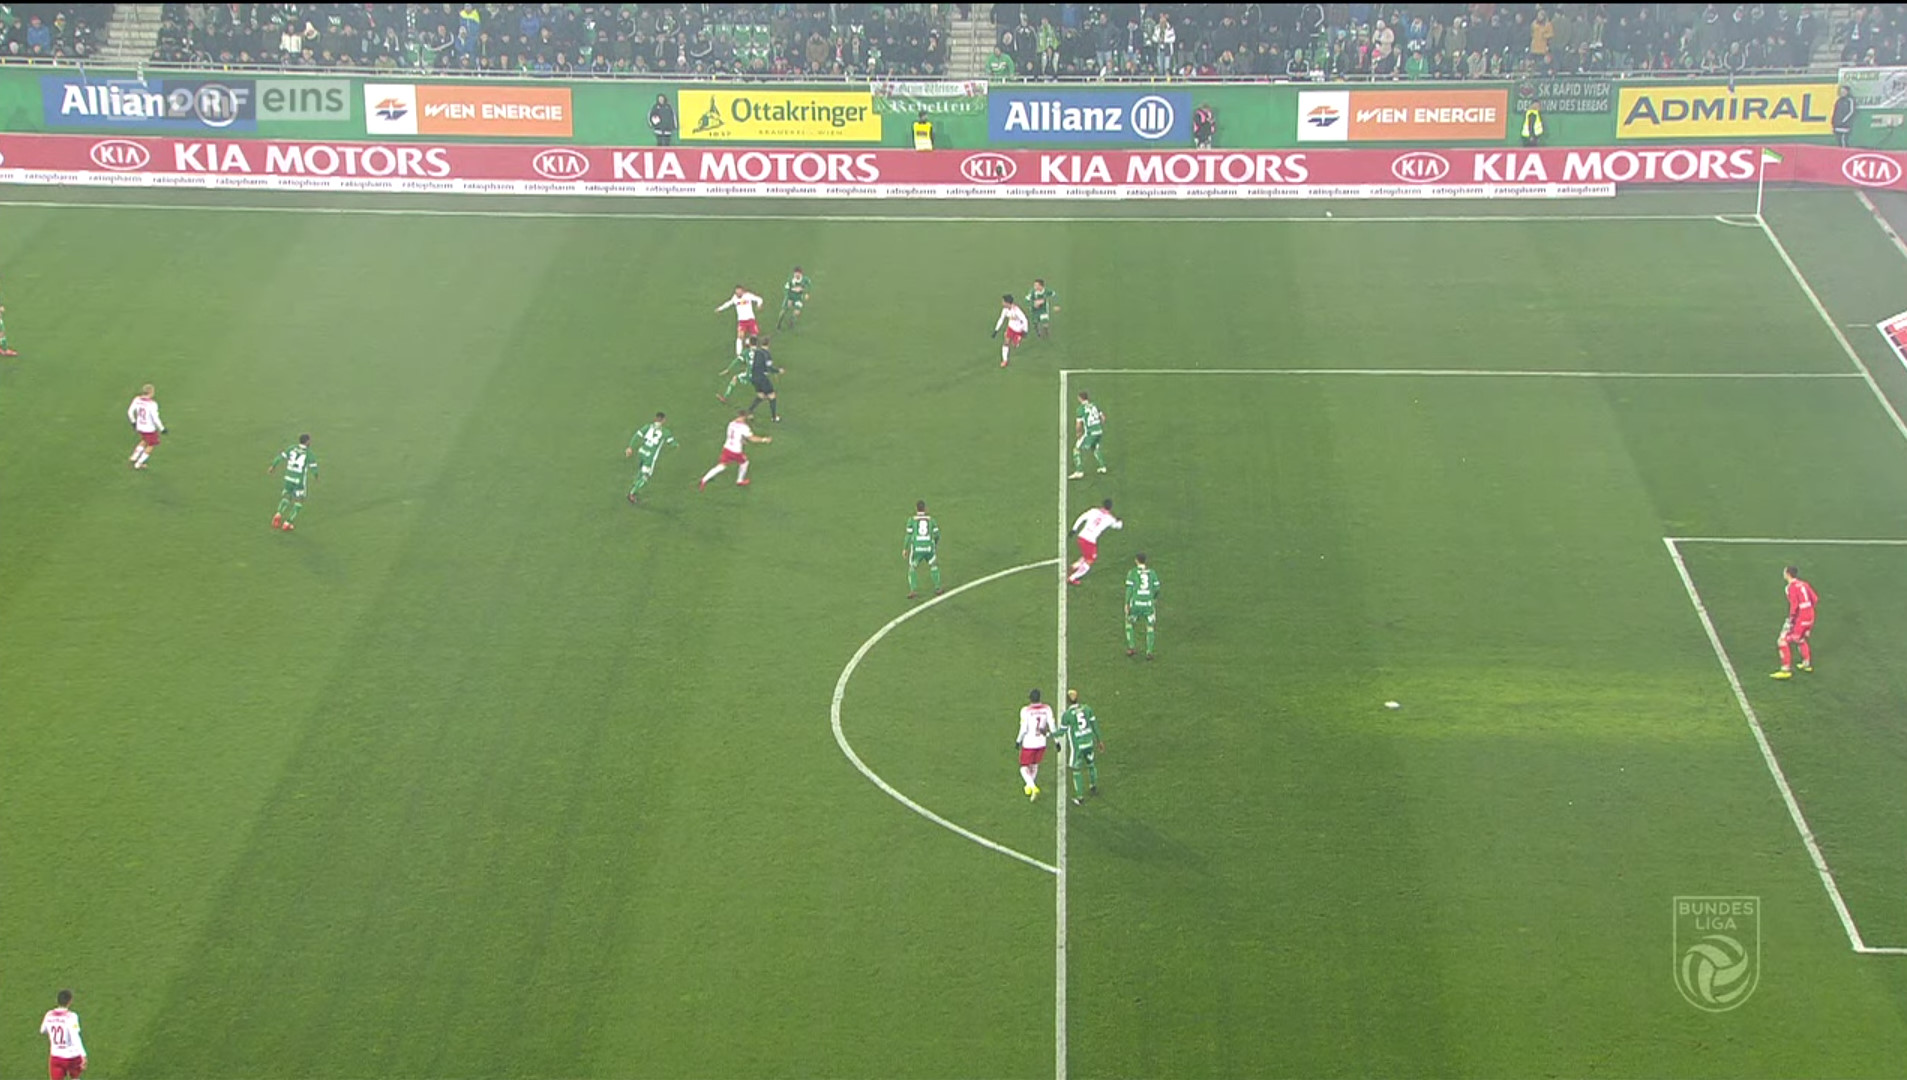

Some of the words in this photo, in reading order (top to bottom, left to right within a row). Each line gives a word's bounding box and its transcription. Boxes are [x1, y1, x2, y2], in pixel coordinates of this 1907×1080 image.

[1539, 83, 1551, 96] SK
[1553, 83, 1580, 96] RAPID
[1584, 82, 1610, 96] WIEN
[424, 103, 476, 119] WIEN
[482, 104, 563, 121] ENERGIE
[731, 97, 868, 127] Ottakringer
[1005, 101, 1122, 131] Allianz
[1356, 109, 1406, 123] WIEN
[1414, 107, 1495, 122] ENERGIE
[1624, 93, 1827, 125] ADMIRAL
[101, 145, 140, 164] KIA
[174, 143, 251, 172] KIA
[265, 144, 451, 178] MOTORS
[541, 155, 582, 173] KIA
[613, 152, 685, 179] KIA
[700, 152, 880, 182] MOTORS
[970, 158, 1007, 176] KIA
[1040, 156, 1112, 182] KIA
[1126, 154, 1308, 183] MOTORS
[1401, 158, 1440, 175] KIA
[1473, 152, 1547, 181] KIA
[1562, 149, 1755, 181] MOTORS
[1852, 160, 1891, 179] KIA
[918, 520, 928, 536] 8
[1140, 574, 1149, 590] 3
[1076, 712, 1087, 730] 5
[51, 1025, 66, 1045] 22
